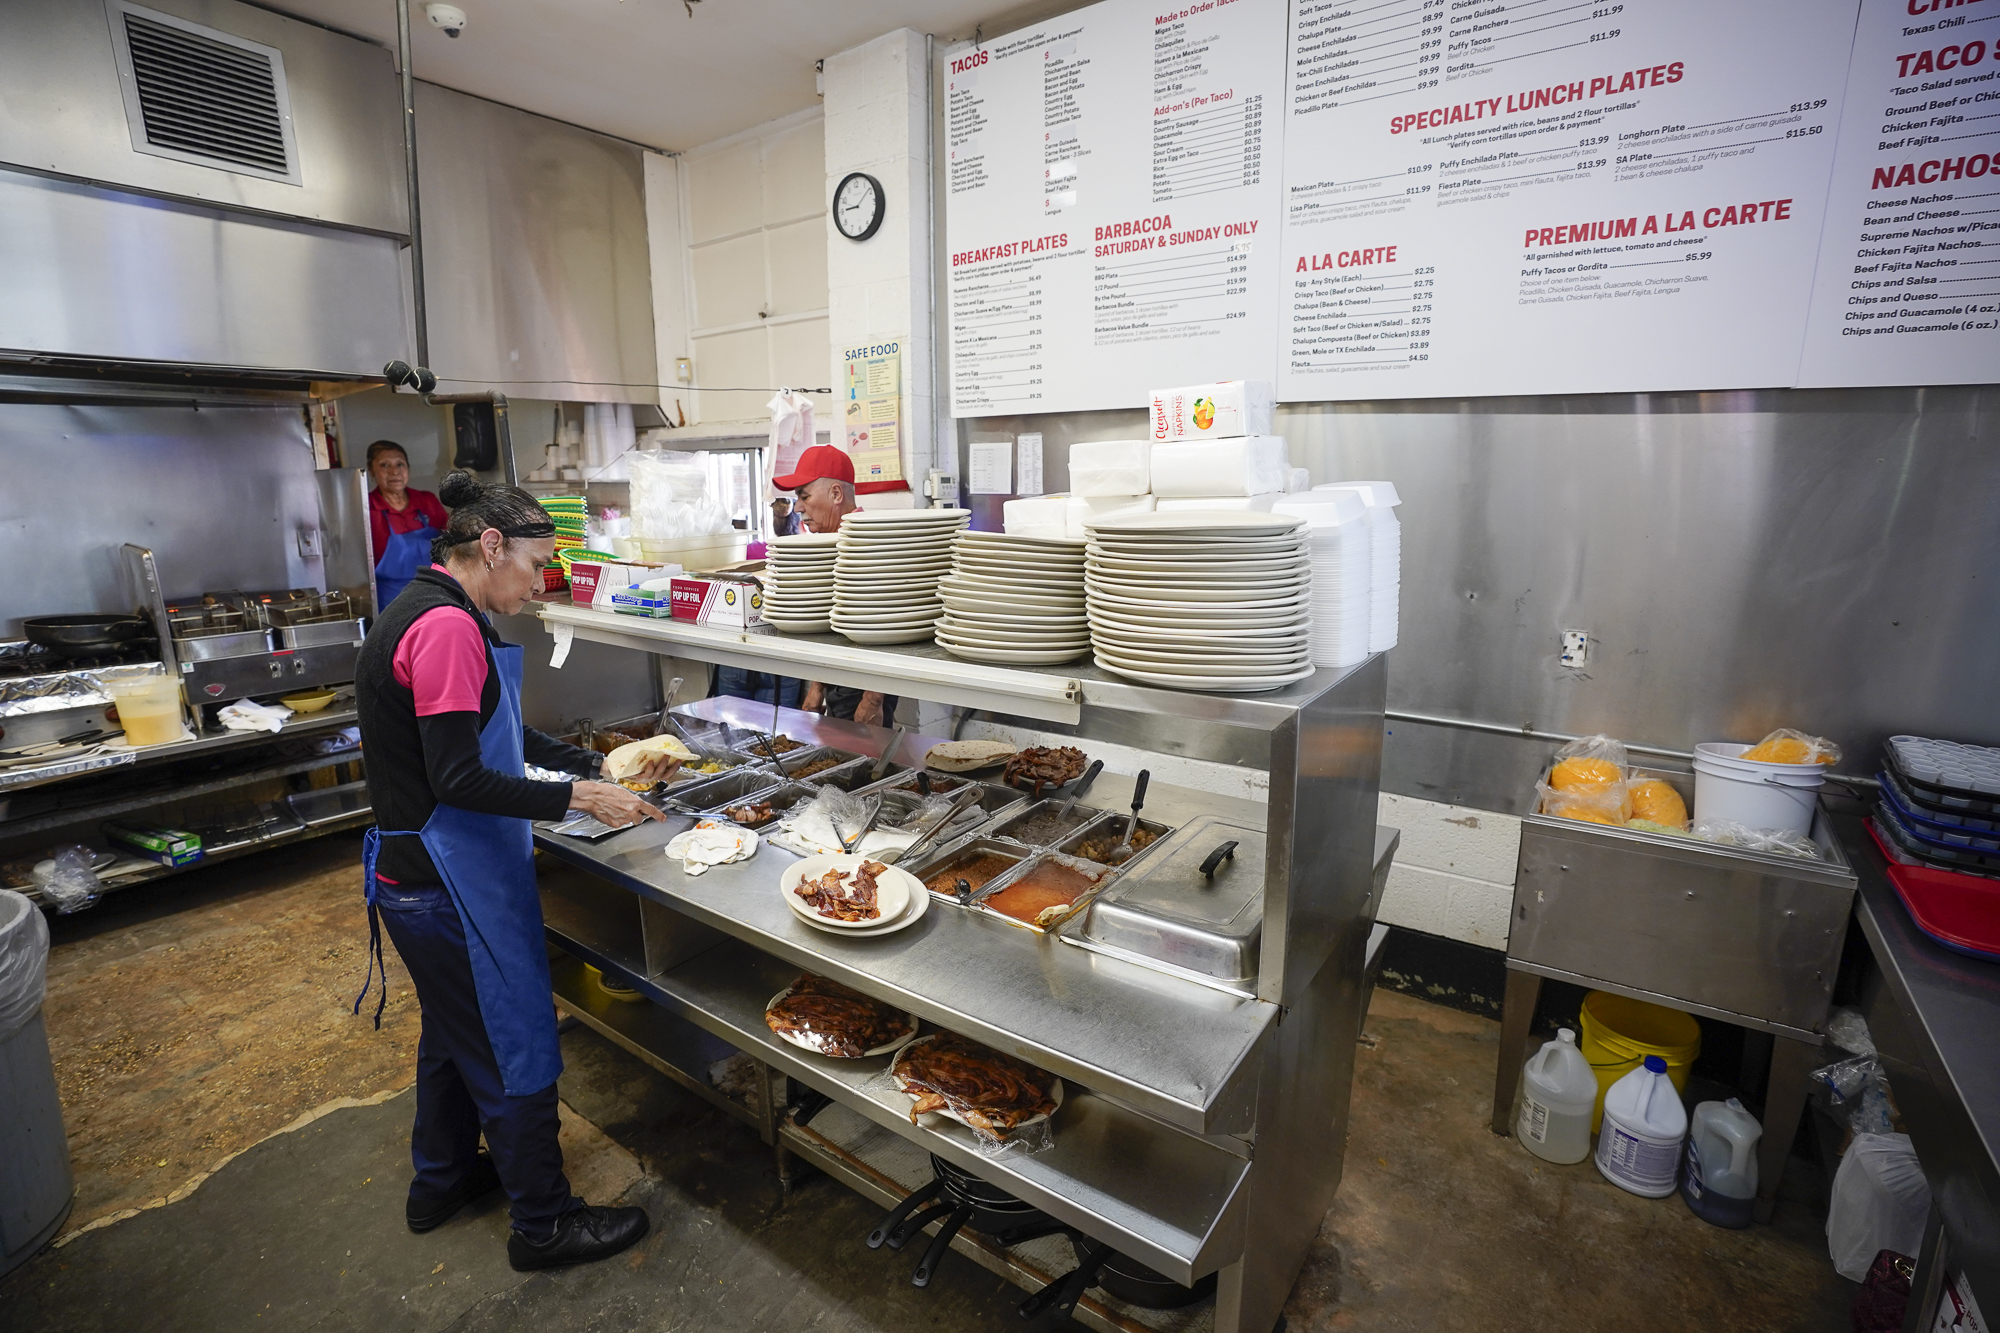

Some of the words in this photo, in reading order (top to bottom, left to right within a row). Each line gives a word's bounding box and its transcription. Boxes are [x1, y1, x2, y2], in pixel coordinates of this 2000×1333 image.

[1155, 13, 1178, 25] Made
[1179, 10, 1188, 18] to
[1190, 2, 1214, 14] Order
[1297, 42, 1321, 54] Cheese
[1322, 34, 1357, 48] Enchiladas
[1422, 12, 1443, 23] $8.99
[1448, 41, 1469, 52] Puffy
[1470, 36, 1492, 47] Tacos
[1592, 5, 1623, 19] $11.99
[1449, 27, 1471, 38] Carne
[1473, 19, 1509, 33] Ranchera
[1902, 24, 1935, 36] Texas
[1938, 16, 1966, 29] Chili
[1155, 38, 1184, 50] Chilaquiles
[1446, 62, 1474, 74] Gordita
[1590, 29, 1620, 43] $11.99
[951, 50, 988, 74] TACOS
[1896, 41, 1986, 78] TACO
[1921, 78, 1952, 91] Salad
[1954, 71, 1994, 86] served
[1154, 101, 1189, 116] Add-on's
[1192, 97, 1208, 108] (Per
[1210, 88, 1233, 102] Taco)
[1295, 105, 1320, 115] Picadillo
[1321, 102, 1338, 110] Plate
[1418, 80, 1438, 90] $9.99
[1390, 97, 1502, 135] SPECIALTY
[1506, 81, 1584, 114] LUNCH
[1589, 62, 1684, 98] PLATES
[1885, 103, 1926, 116] Ground
[1929, 97, 1957, 110] Beef
[1960, 96, 1972, 104] or
[1154, 131, 1182, 141] Guacamole
[1245, 112, 1262, 121] $0.89
[1432, 134, 1452, 143] Lunch
[1454, 131, 1475, 141] plates
[1477, 126, 1501, 136] served
[1502, 122, 1518, 131] with
[1520, 119, 1535, 129] rice,
[1537, 116, 1559, 124] beans
[1561, 112, 1576, 120] and
[1584, 108, 1602, 116] flour
[1619, 128, 1660, 141] Longhorn
[1662, 123, 1685, 134] Plate
[1790, 99, 1827, 113] $13.99
[1621, 139, 1650, 147] cheese
[1652, 133, 1691, 145] enchiladas
[1717, 126, 1733, 134] side
[1735, 123, 1744, 131] of
[1745, 120, 1767, 130] carne
[1769, 115, 1802, 128] guisada
[1882, 122, 1927, 133] Chicken
[1930, 115, 1963, 127] Fajita
[1489, 131, 1516, 143] tortillas
[1518, 129, 1536, 138] upon
[1616, 156, 1628, 164] SA
[1630, 153, 1652, 162] Plate
[1786, 126, 1823, 139] $15.50
[1878, 139, 1905, 150] Beef
[1907, 135, 1939, 147] Fajita
[1440, 160, 1460, 170] Puffy
[1461, 154, 1497, 165] Enchilada
[1499, 151, 1518, 159] Plate
[1579, 135, 1609, 147] $13.99
[1243, 178, 1259, 186] $0.45
[1291, 184, 1316, 193] Mexican
[1408, 164, 1432, 174] $10.99
[1867, 199, 1907, 209] Cheese
[1910, 194, 1953, 205] Nachos
[1095, 215, 1172, 241] BARBACOA
[1525, 217, 1637, 247] PREMIUM
[1642, 216, 1658, 235] A
[1665, 211, 1695, 232] LA
[1703, 199, 1793, 228] CARTE
[1863, 217, 1891, 226] Bean
[1893, 215, 1914, 223] and
[1917, 210, 1959, 220] Cheese
[1095, 237, 1155, 257] SATURDAY
[1158, 235, 1166, 247] &
[1170, 226, 1221, 245] SUNDAY
[1224, 220, 1258, 237] ONLY
[1860, 230, 1909, 242] Supreme
[1912, 226, 1954, 237] Nachos
[953, 242, 1018, 266] BREAKFAST
[1022, 233, 1068, 254] PLATES
[1296, 257, 1307, 272] A
[1312, 254, 1333, 271] LA
[1338, 246, 1397, 268] CARTE
[1536, 249, 1573, 261] garnished
[1575, 248, 1592, 256] with
[1593, 246, 1623, 254] lettuce,
[1625, 242, 1654, 251] tomato
[1656, 238, 1671, 247] and
[1858, 247, 1900, 257] Chicken
[1903, 244, 1934, 255] Fajita
[1937, 240, 1981, 250] Nachos
[1521, 268, 1542, 277] Puffy
[1544, 266, 1565, 275] Tacos
[1578, 262, 1608, 272] Gordita
[1686, 252, 1712, 261] $5.99
[1851, 280, 1881, 290] Chips
[1883, 279, 1903, 287] and
[1906, 276, 1937, 285] Salsa
[1294, 302, 1318, 310] Chalupa
[1413, 292, 1432, 300] $2.75
[1842, 328, 1871, 336] Chips
[1874, 326, 1894, 334] and
[1897, 321, 1958, 333] Guacamole
[1961, 320, 1973, 331] (6
[1976, 320, 1998, 329] oz.)
[845, 348, 868, 361] SAFE
[871, 343, 898, 357] FOOD
[1176, 395, 1184, 436] NAPKINS
[587, 578, 595, 586] FOIL
[673, 591, 682, 600] POP
[683, 593, 689, 601] UP
[690, 594, 700, 603] FOIL
